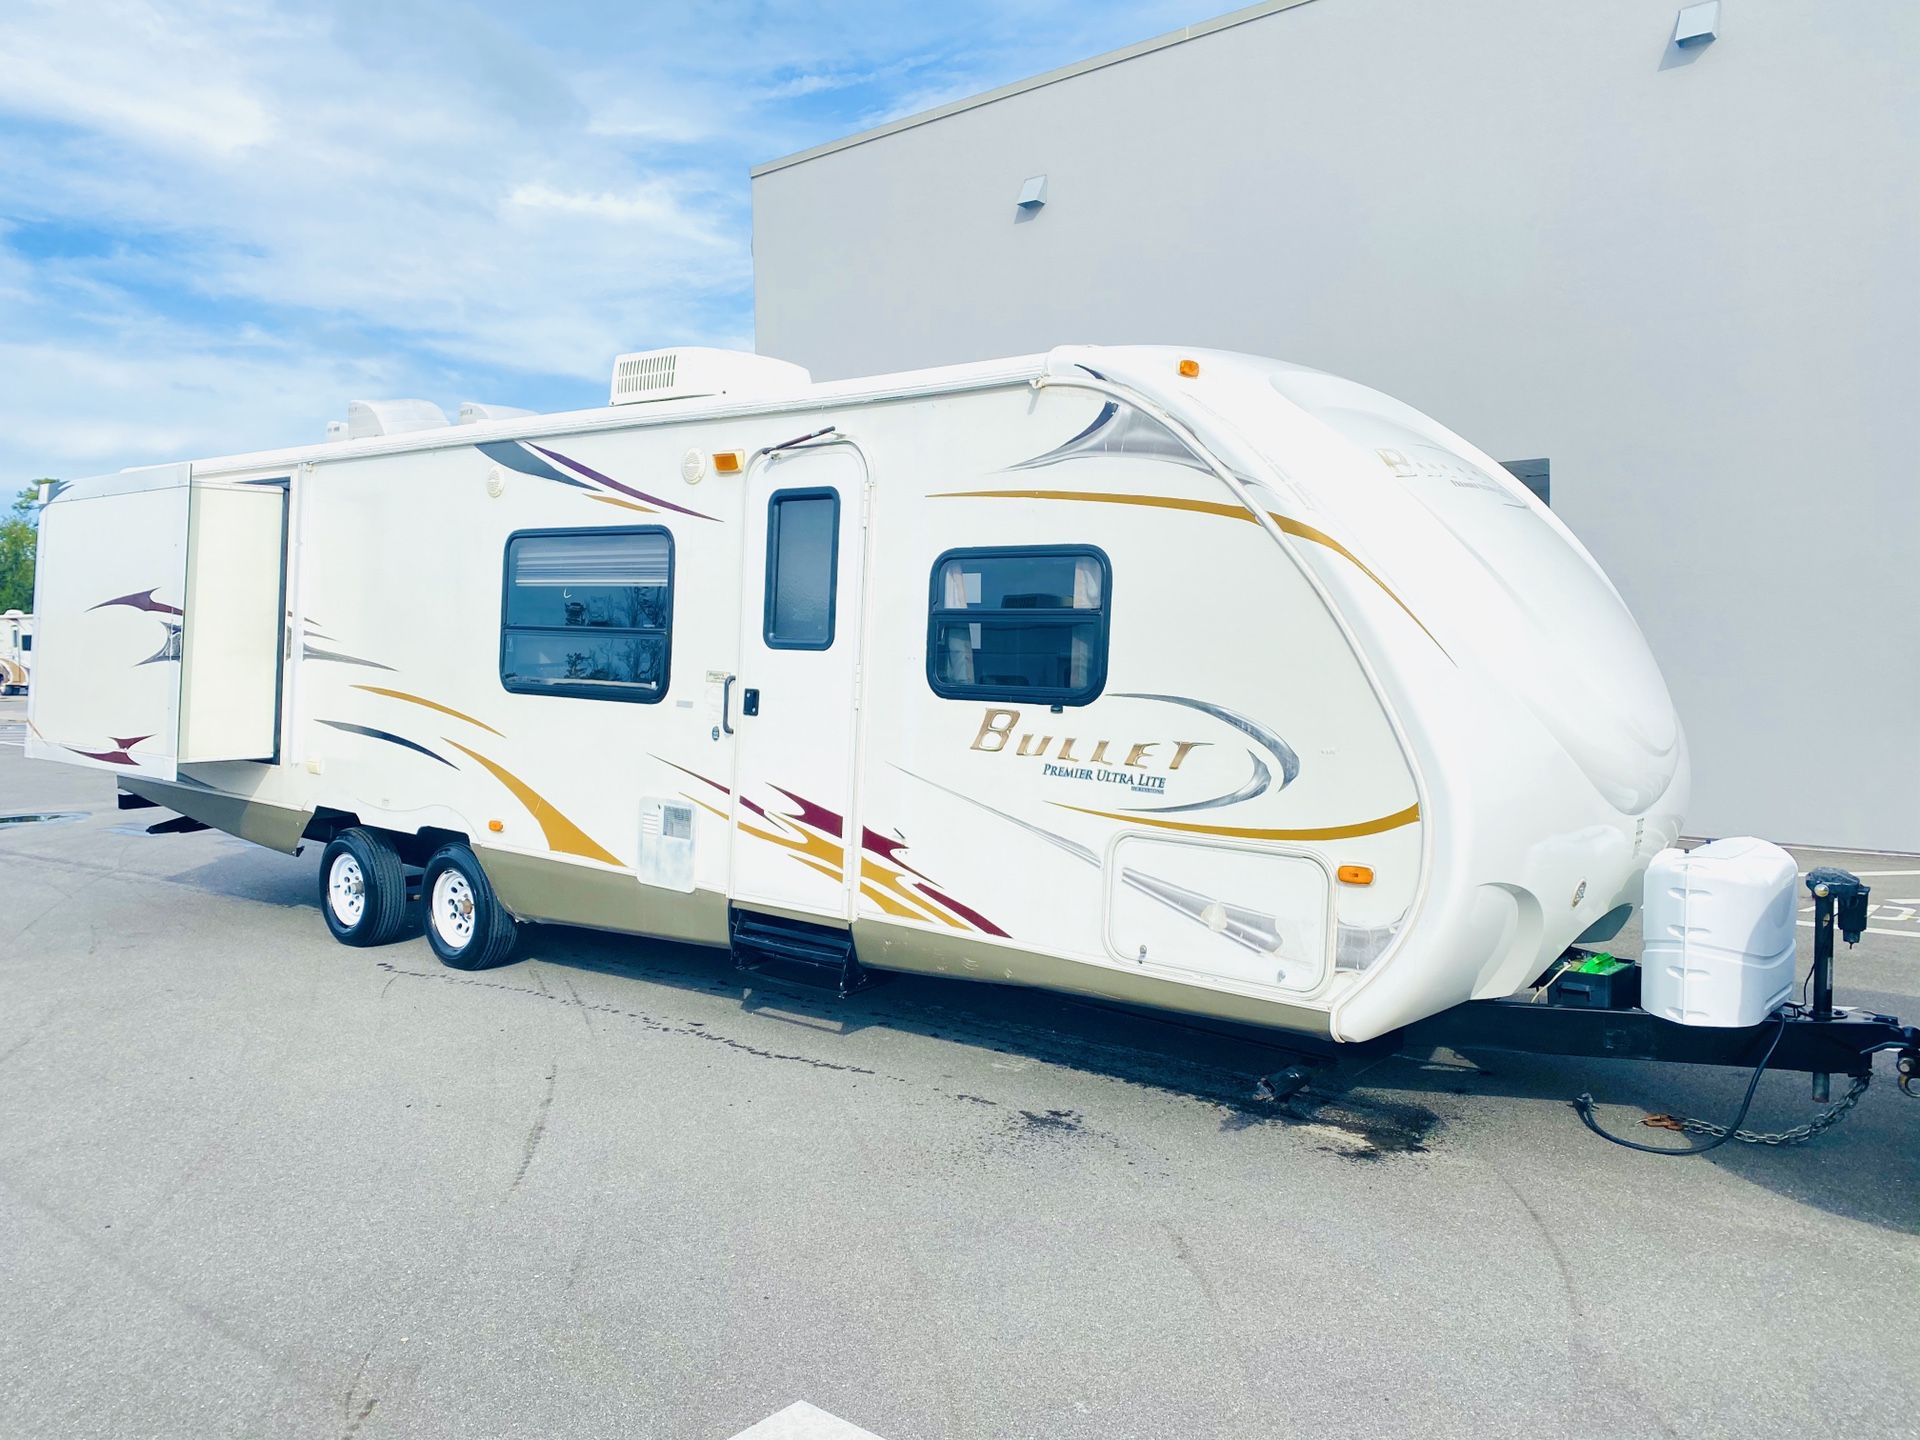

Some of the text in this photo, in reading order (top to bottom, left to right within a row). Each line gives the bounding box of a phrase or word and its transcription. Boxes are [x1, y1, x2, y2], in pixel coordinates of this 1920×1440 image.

[970, 709, 1215, 770] BULLET
[1043, 764, 1166, 788] PREMIER ULTRA LITE
